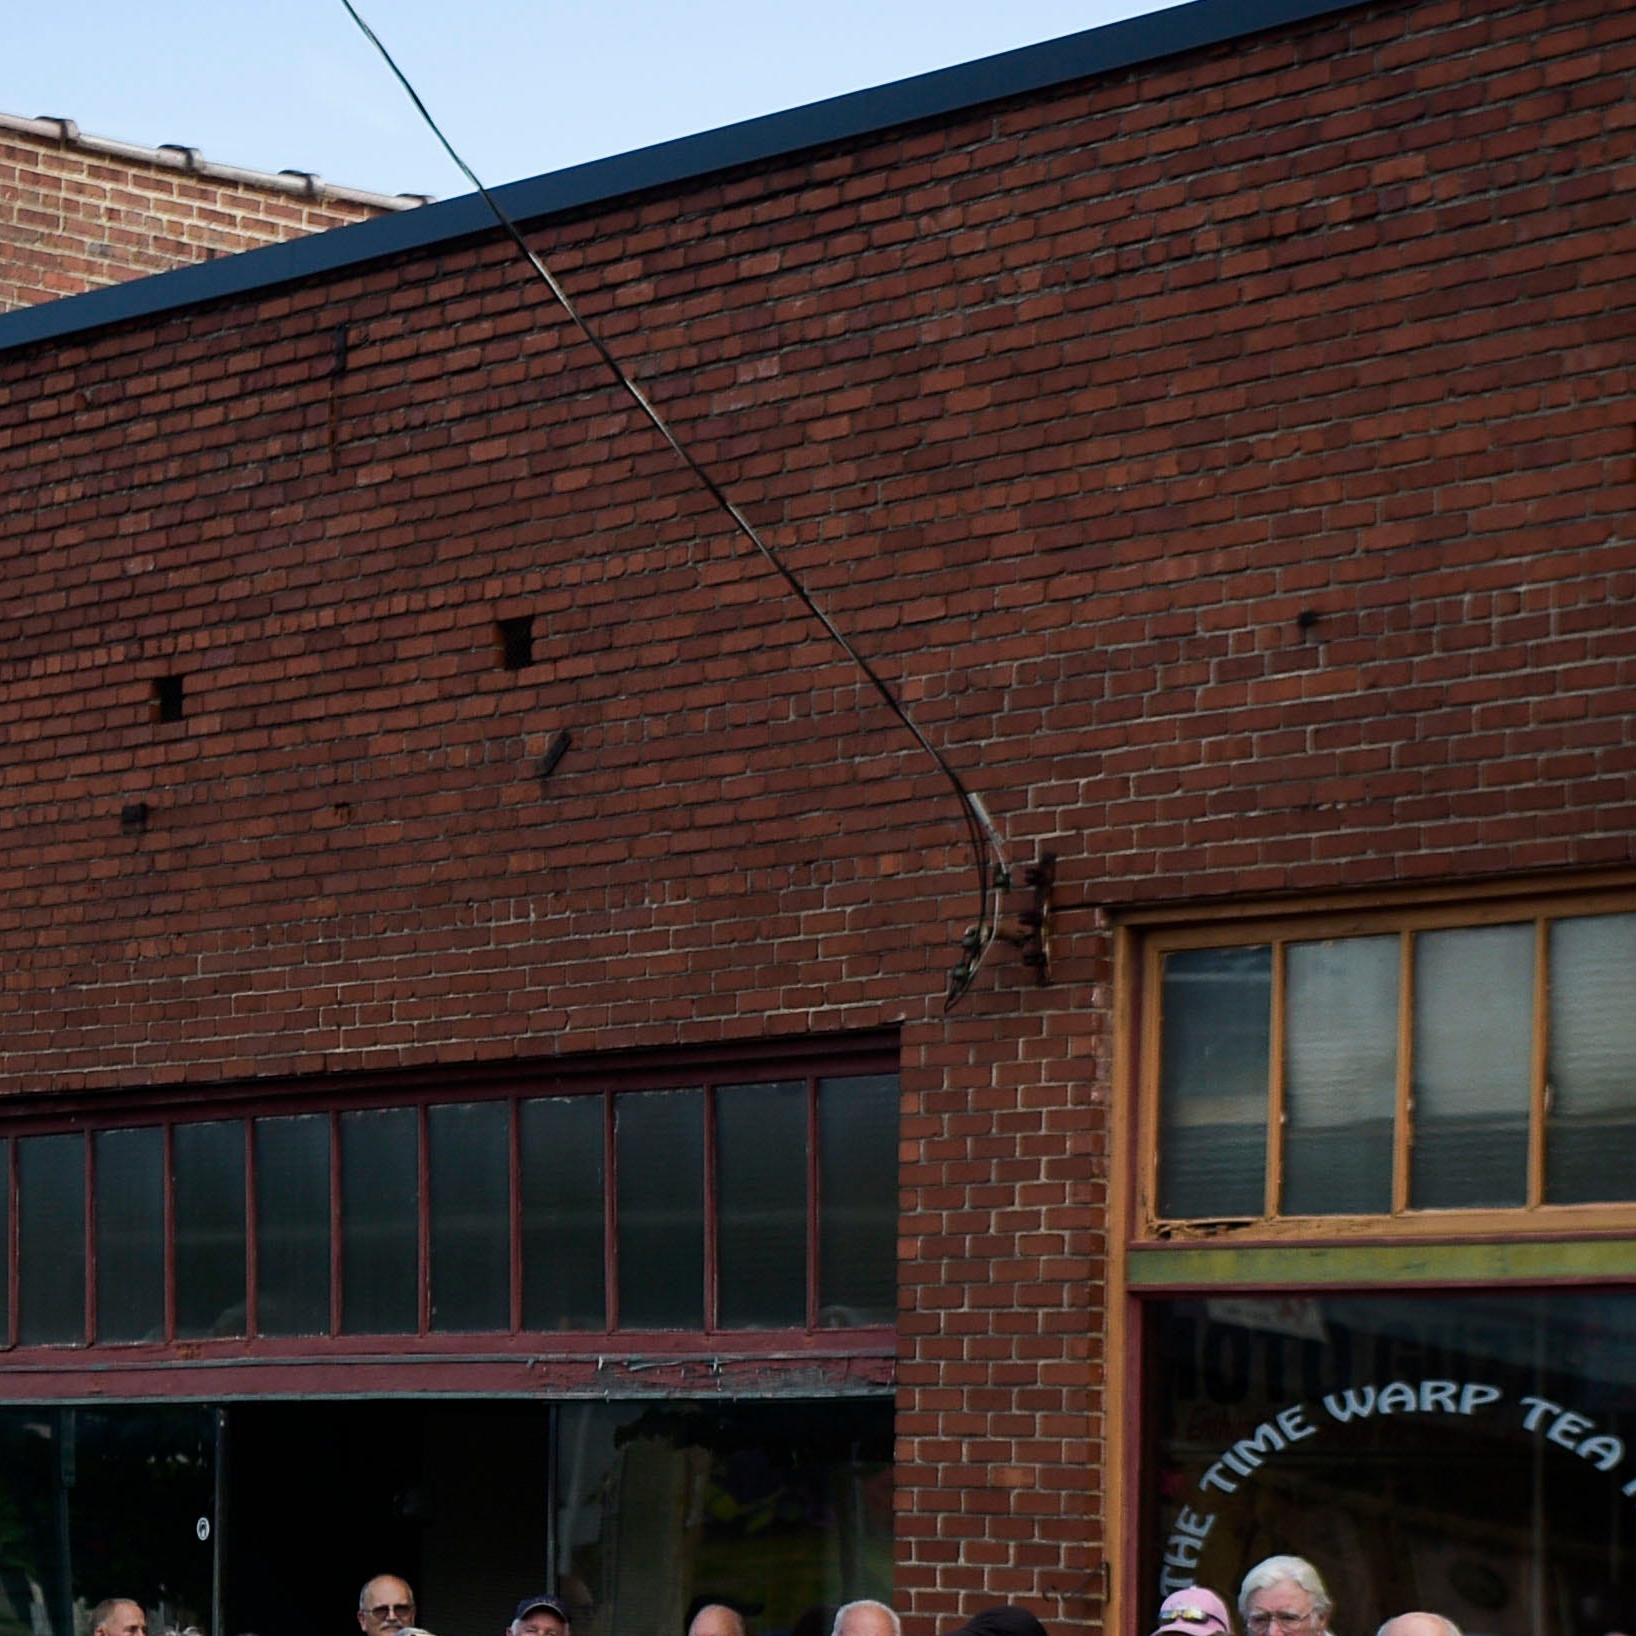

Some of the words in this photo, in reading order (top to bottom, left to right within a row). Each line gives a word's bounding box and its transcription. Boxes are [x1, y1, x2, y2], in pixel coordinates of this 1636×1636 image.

[1199, 1404, 1317, 1494] TIME
[1323, 1380, 1502, 1420] WARP
[1519, 1396, 1624, 1471] TEA
